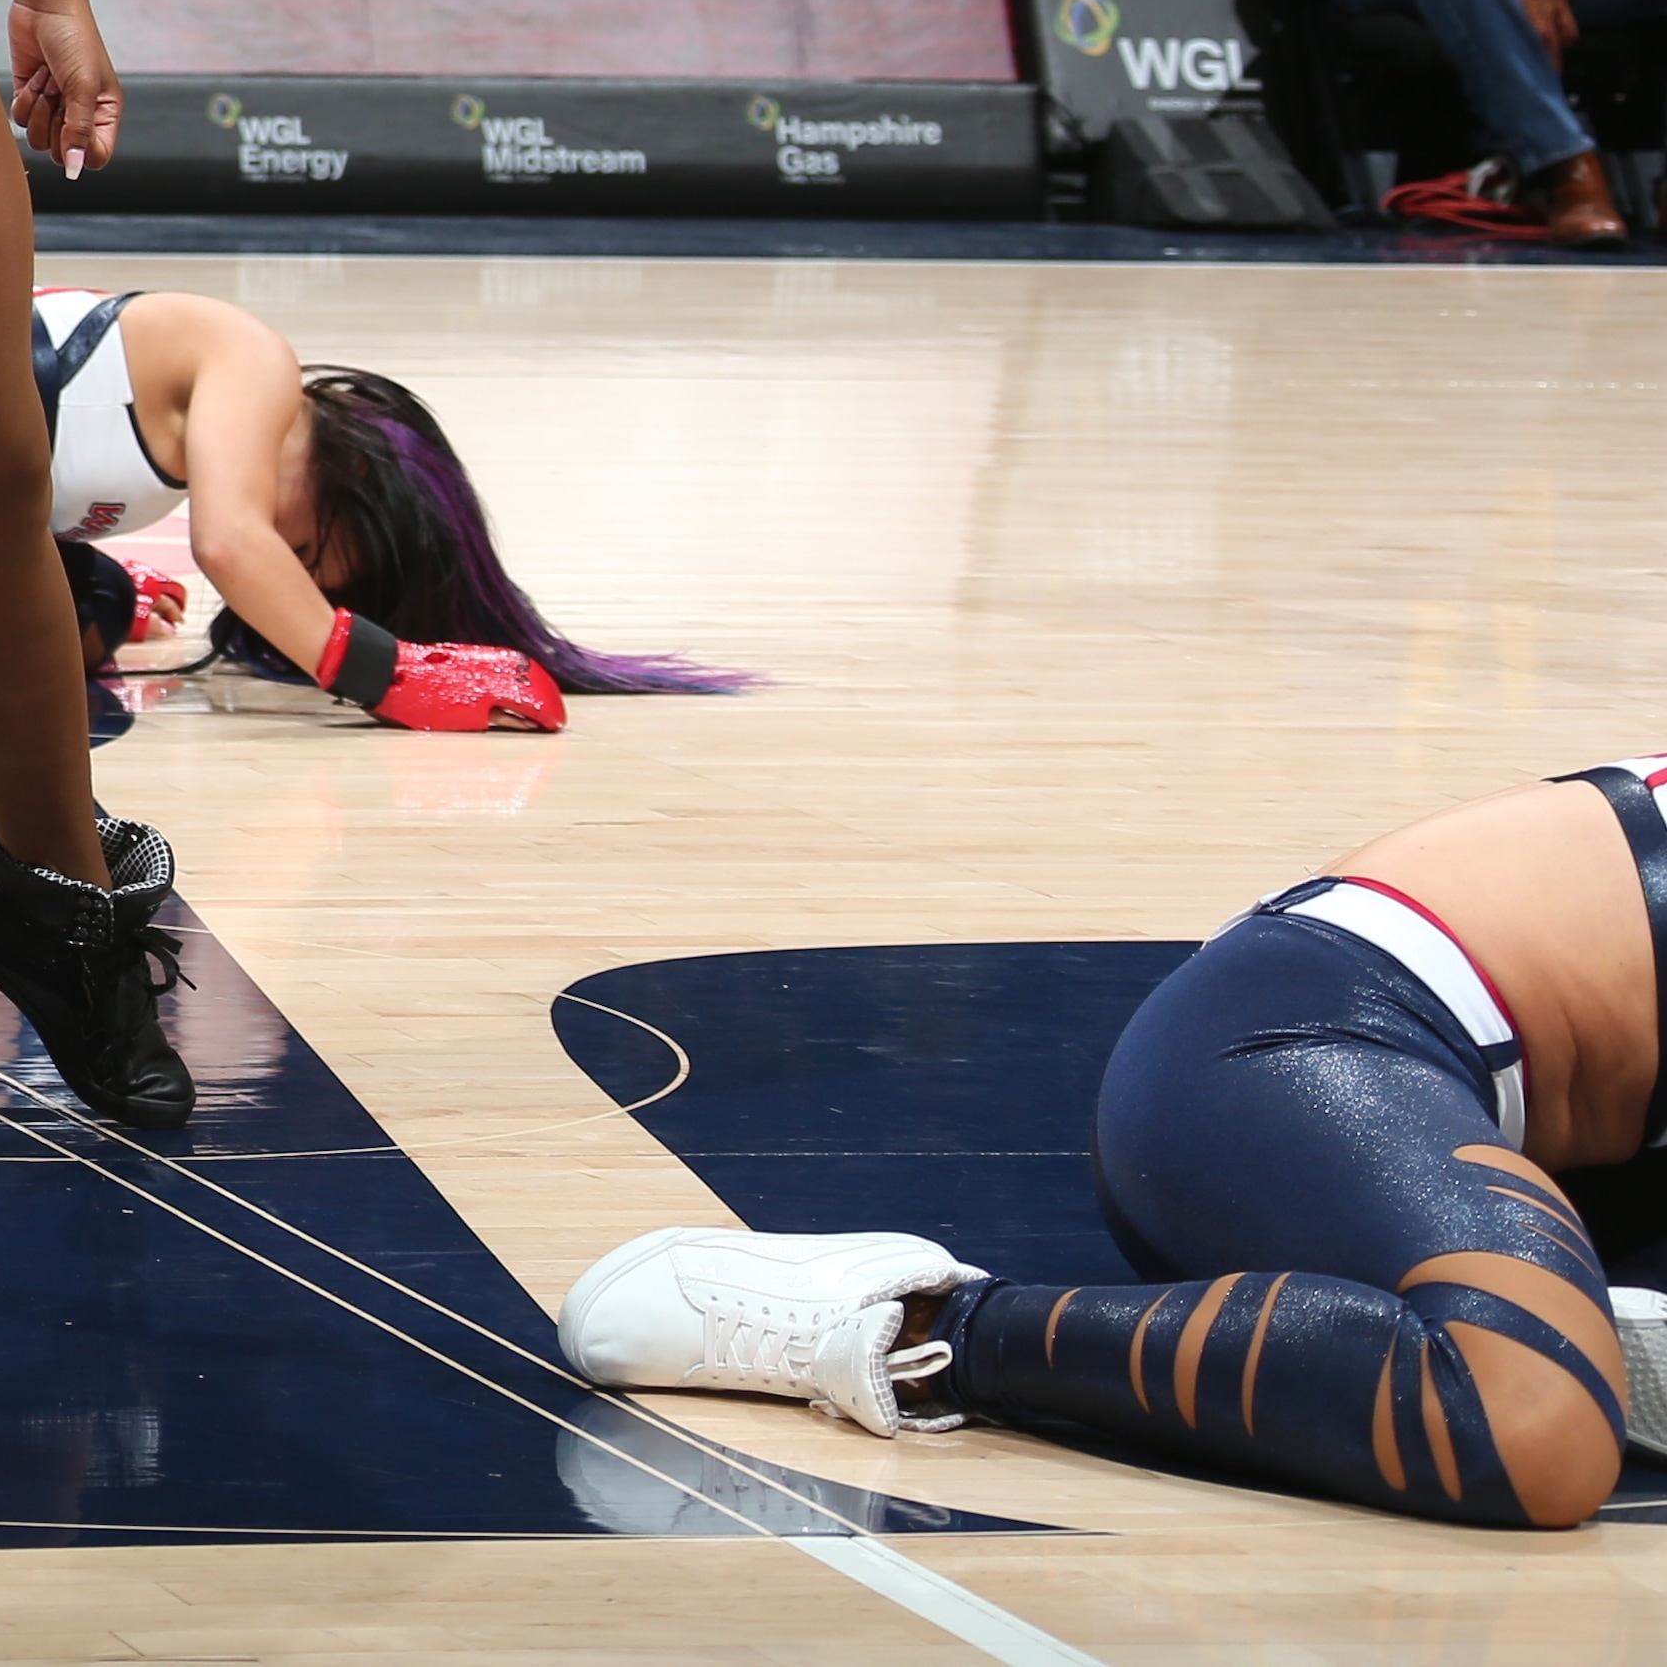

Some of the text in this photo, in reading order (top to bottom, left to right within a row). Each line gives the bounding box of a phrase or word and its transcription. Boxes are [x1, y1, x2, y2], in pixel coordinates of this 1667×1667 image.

[1116, 36, 1263, 91] WGL
[238, 116, 312, 145] WGL
[481, 116, 554, 145] WGL
[775, 114, 943, 151] Hampshire
[238, 145, 349, 180] Energy
[481, 144, 647, 173] Midstream
[776, 145, 840, 175] Gas
